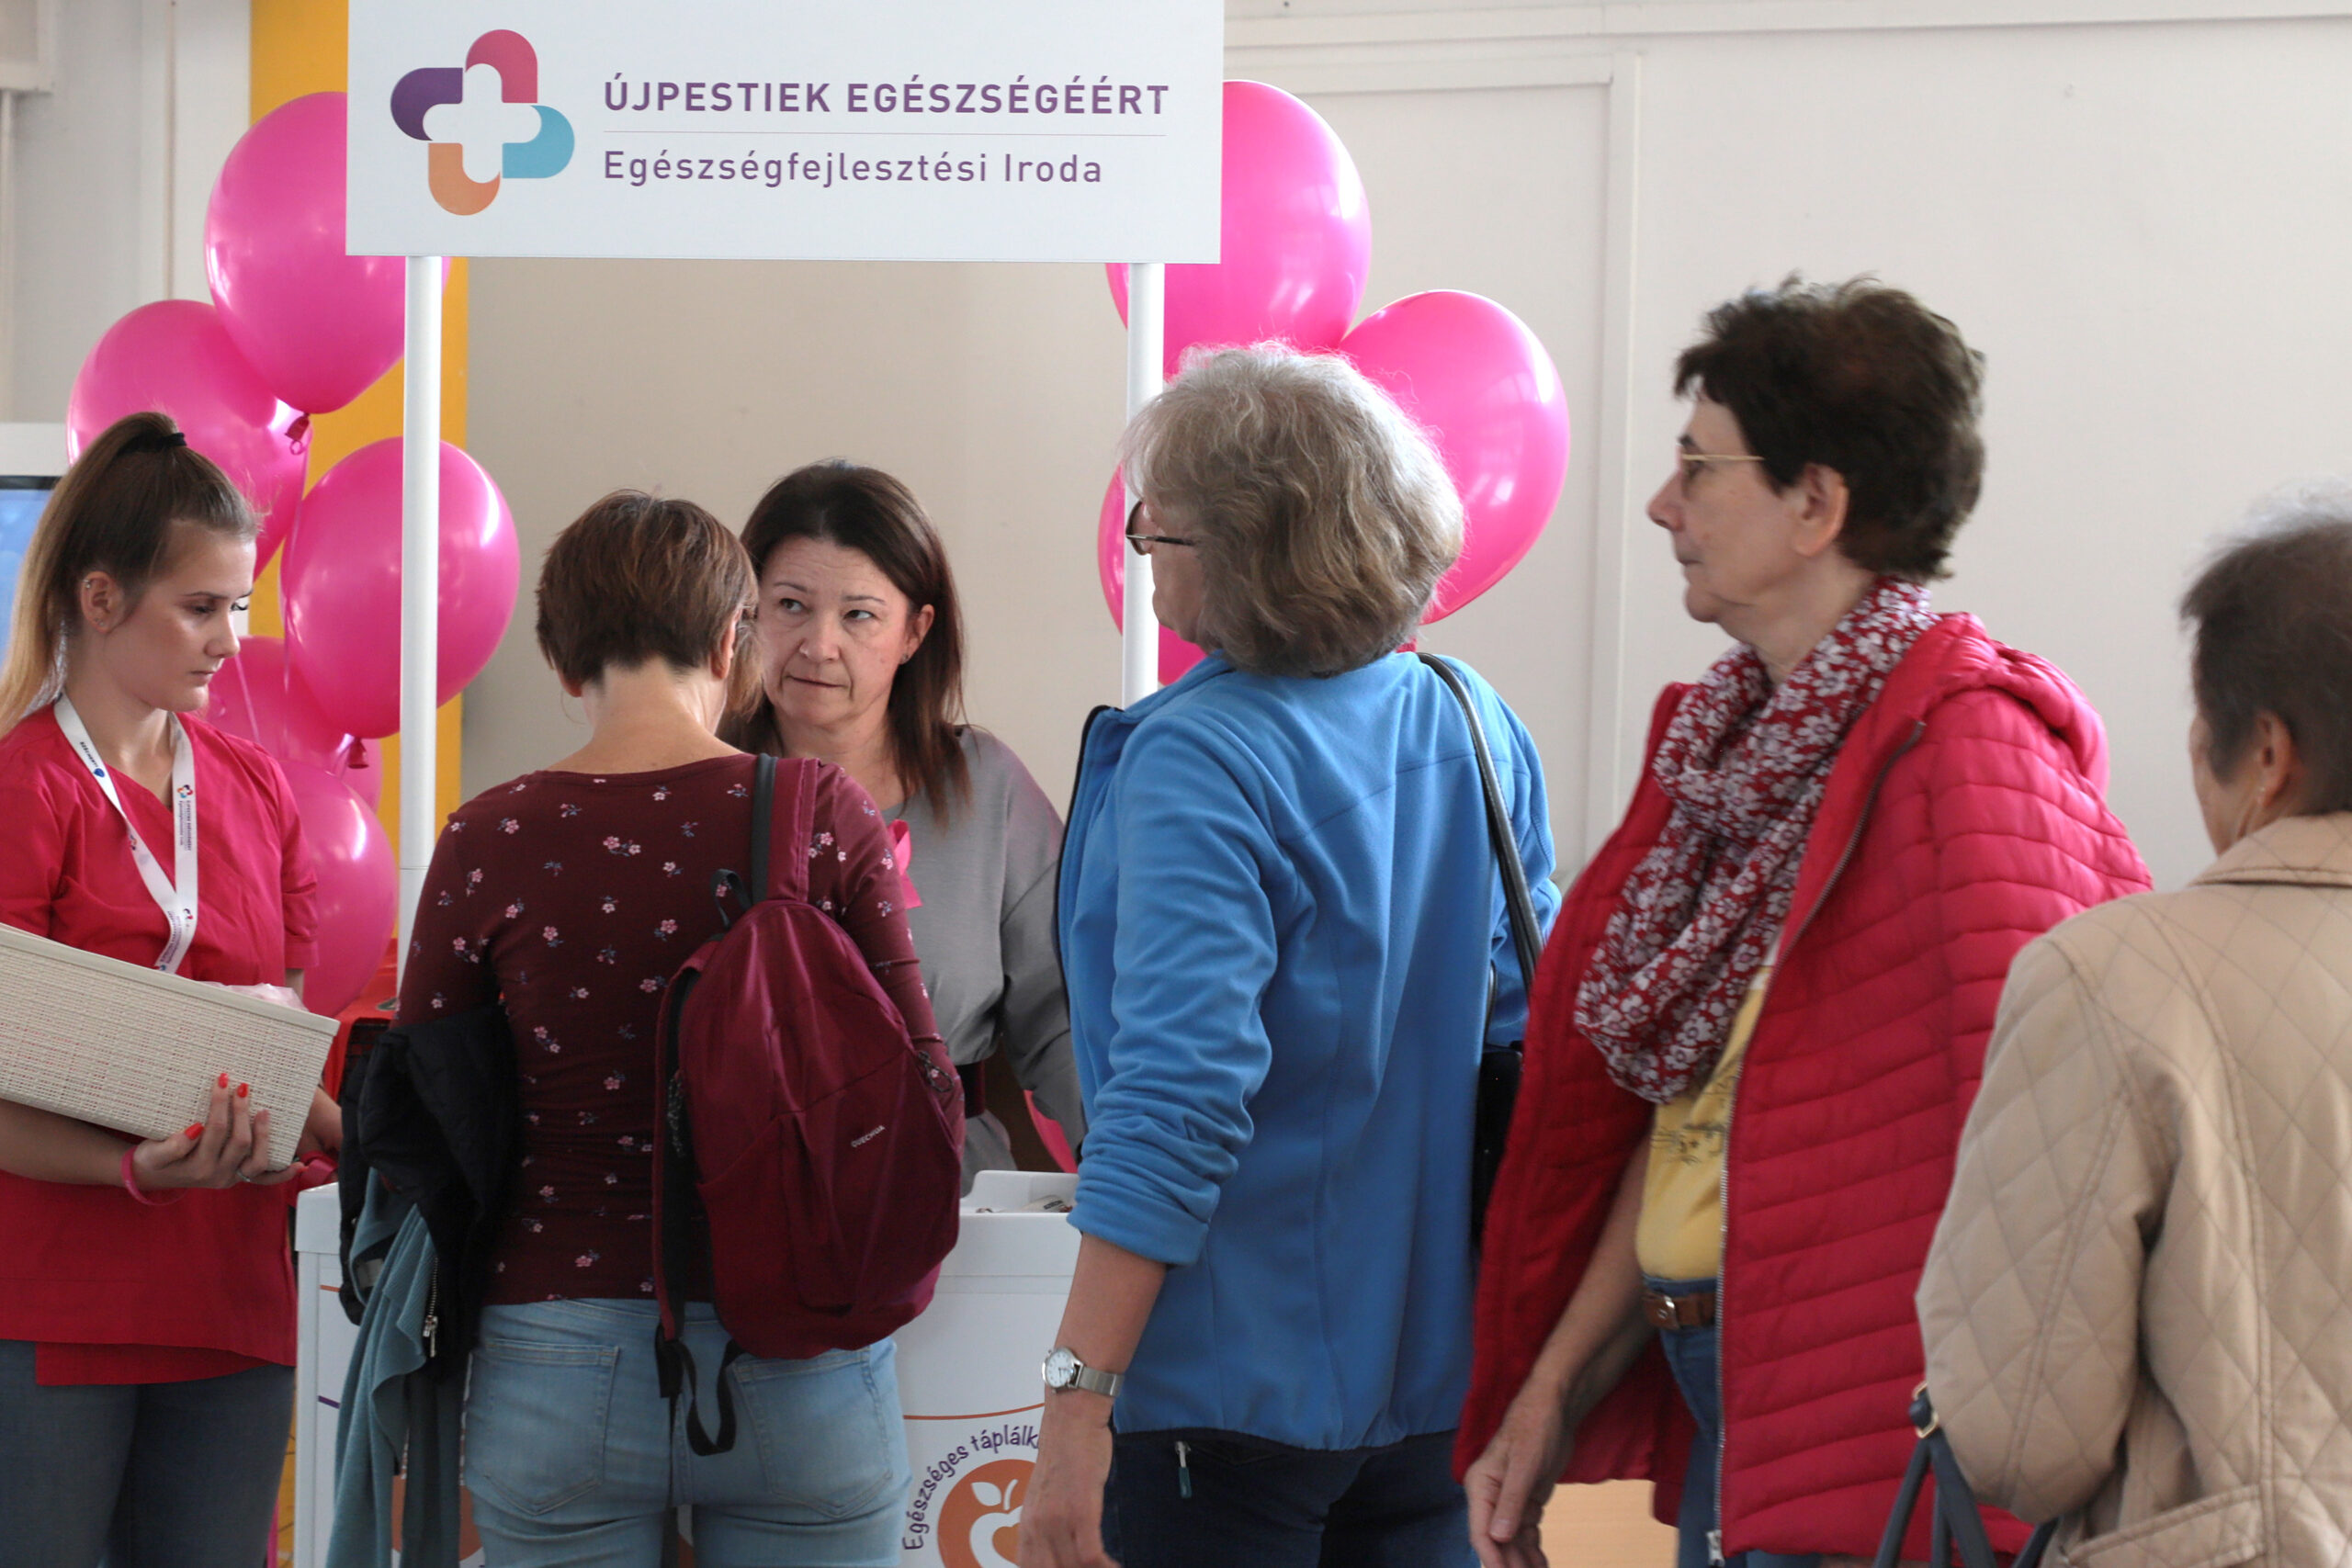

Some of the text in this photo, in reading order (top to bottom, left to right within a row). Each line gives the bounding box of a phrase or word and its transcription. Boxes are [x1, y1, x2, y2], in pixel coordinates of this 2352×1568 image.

[605, 73, 1170, 116] ÚJPESTIEK EGÉSZSÉGÉÉRT
[604, 149, 1102, 188] Egészségfejlesztési Iroda
[902, 1445, 969, 1551] Egészséges
